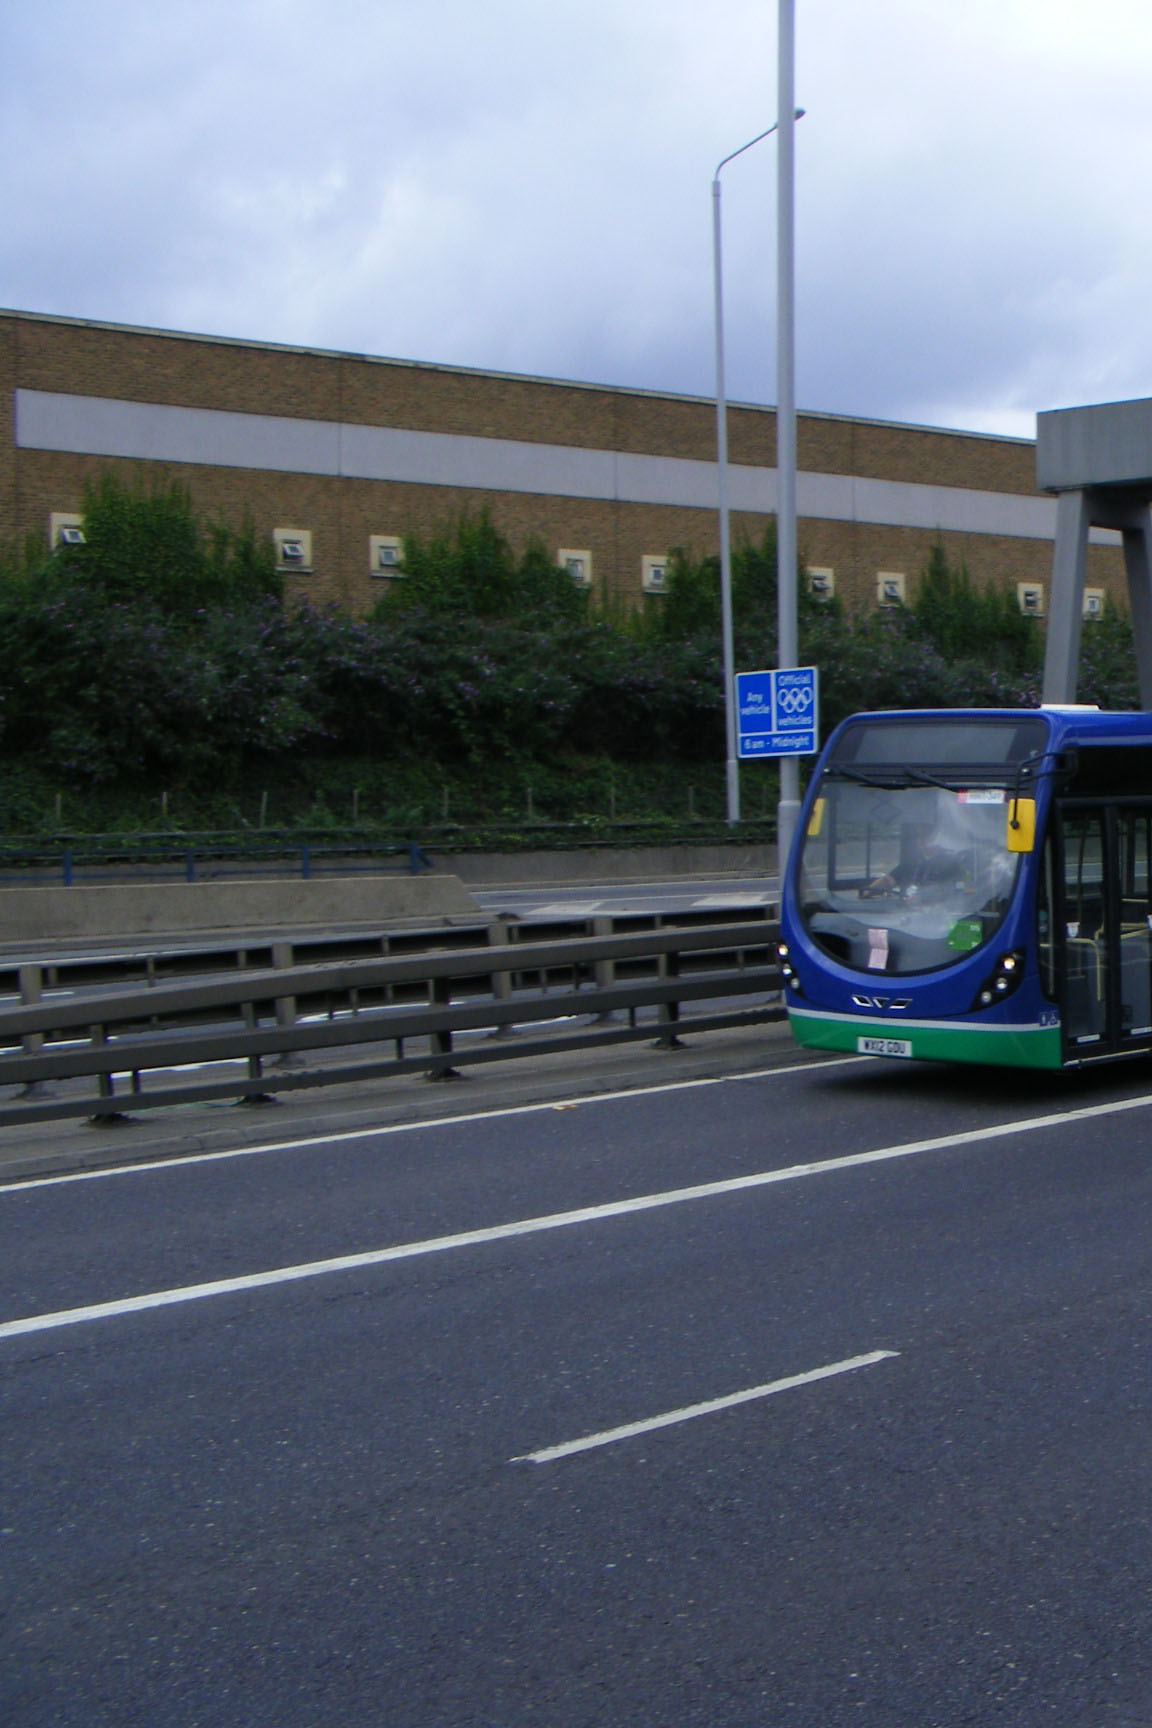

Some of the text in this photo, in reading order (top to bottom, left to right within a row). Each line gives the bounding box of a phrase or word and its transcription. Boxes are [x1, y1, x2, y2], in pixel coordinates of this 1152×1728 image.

[747, 692, 763, 704] Any
[741, 704, 770, 715] vehicle
[779, 715, 812, 725] vehicles
[772, 736, 809, 748] Midnight
